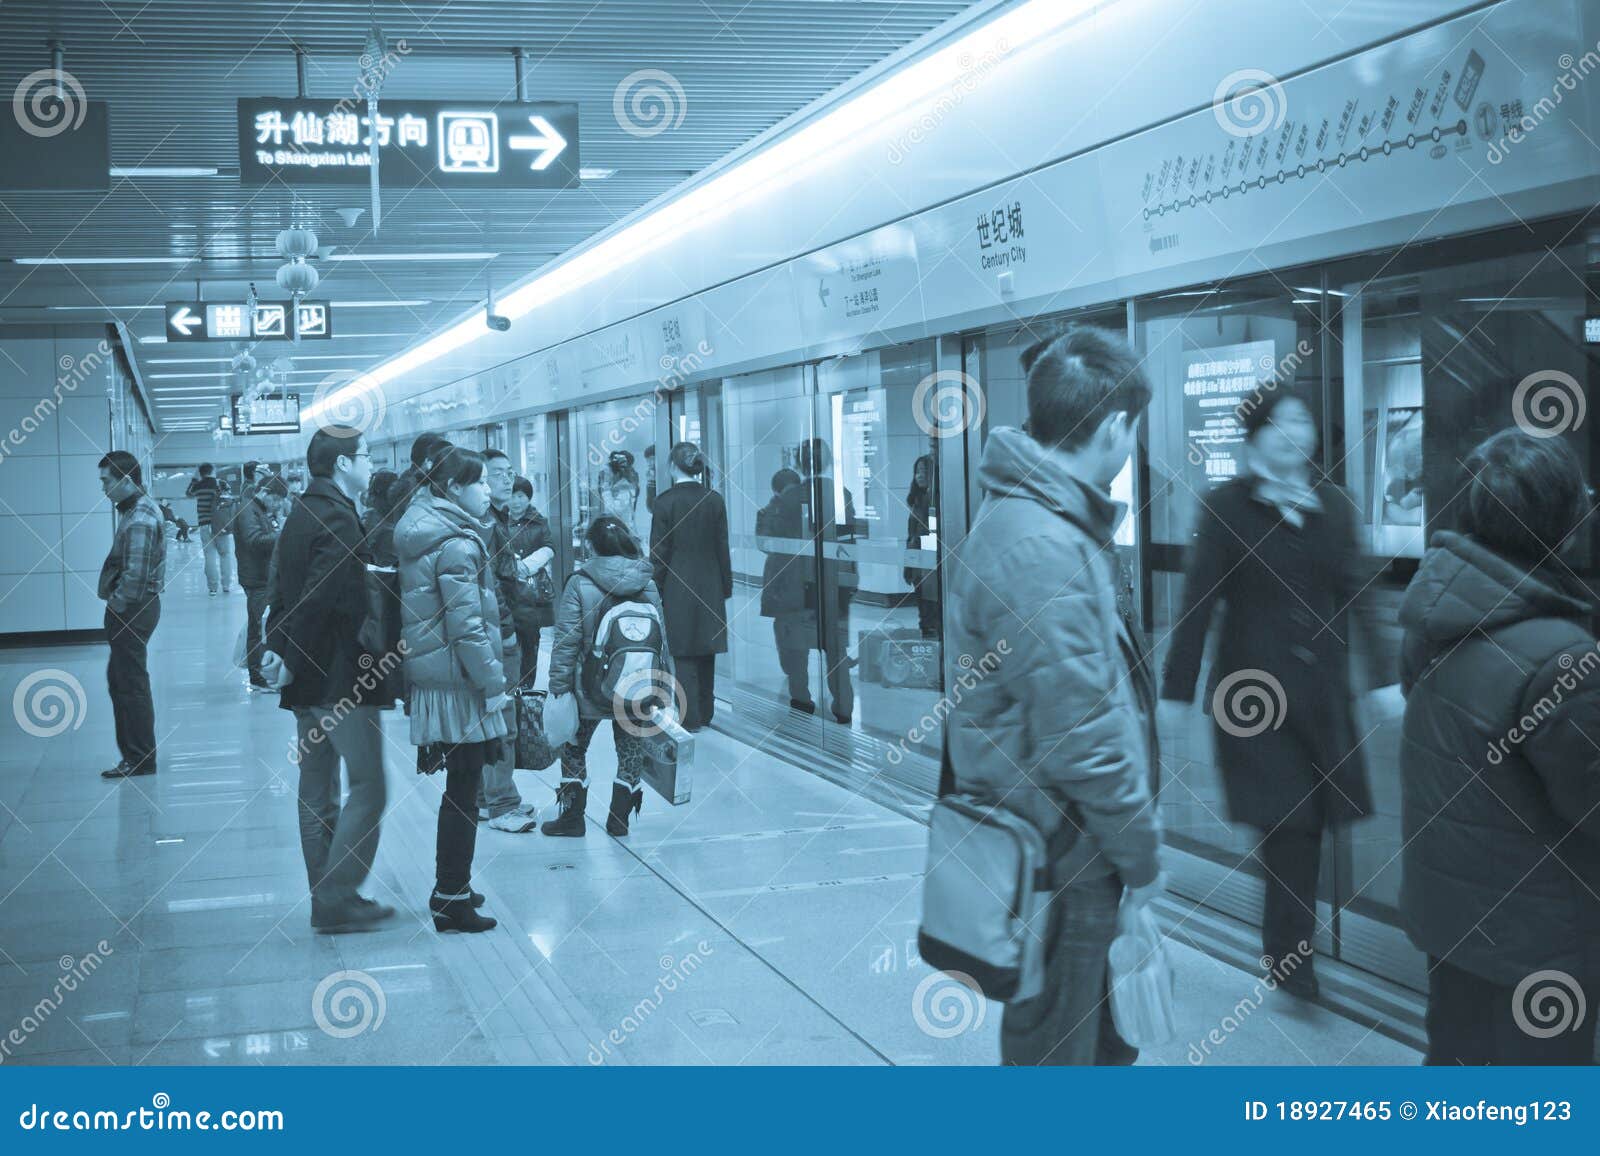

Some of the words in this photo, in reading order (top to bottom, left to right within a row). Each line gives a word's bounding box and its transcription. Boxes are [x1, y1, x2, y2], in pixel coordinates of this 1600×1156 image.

[255, 111, 428, 146] 升仙湖方向
[256, 150, 274, 164] To
[347, 151, 379, 165] Lak
[976, 201, 1025, 250] 世纪城
[981, 251, 1009, 270] Century
[1010, 246, 1026, 264] City
[215, 327, 241, 337] EXIT
